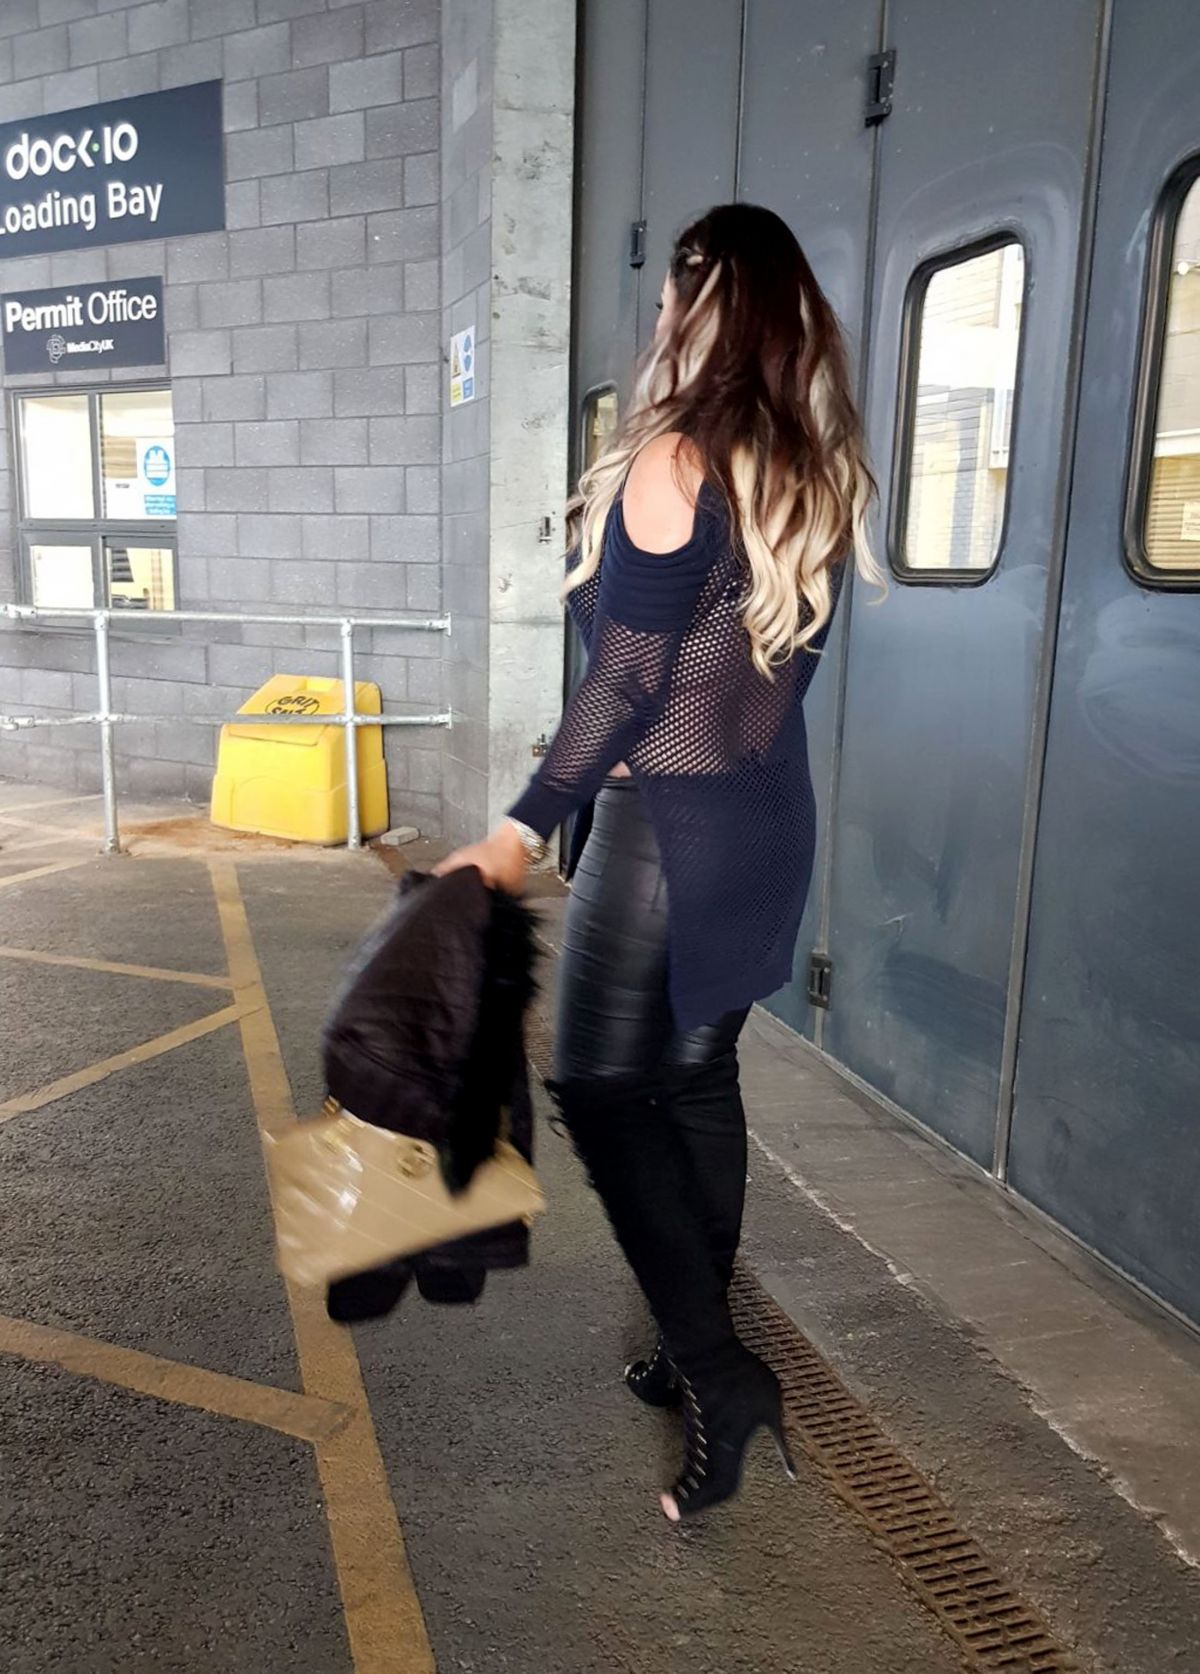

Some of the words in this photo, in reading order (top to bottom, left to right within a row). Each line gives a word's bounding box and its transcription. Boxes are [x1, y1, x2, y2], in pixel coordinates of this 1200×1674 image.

[107, 181, 163, 222] Bay
[5, 296, 83, 333] Permit
[88, 289, 157, 324] Office
